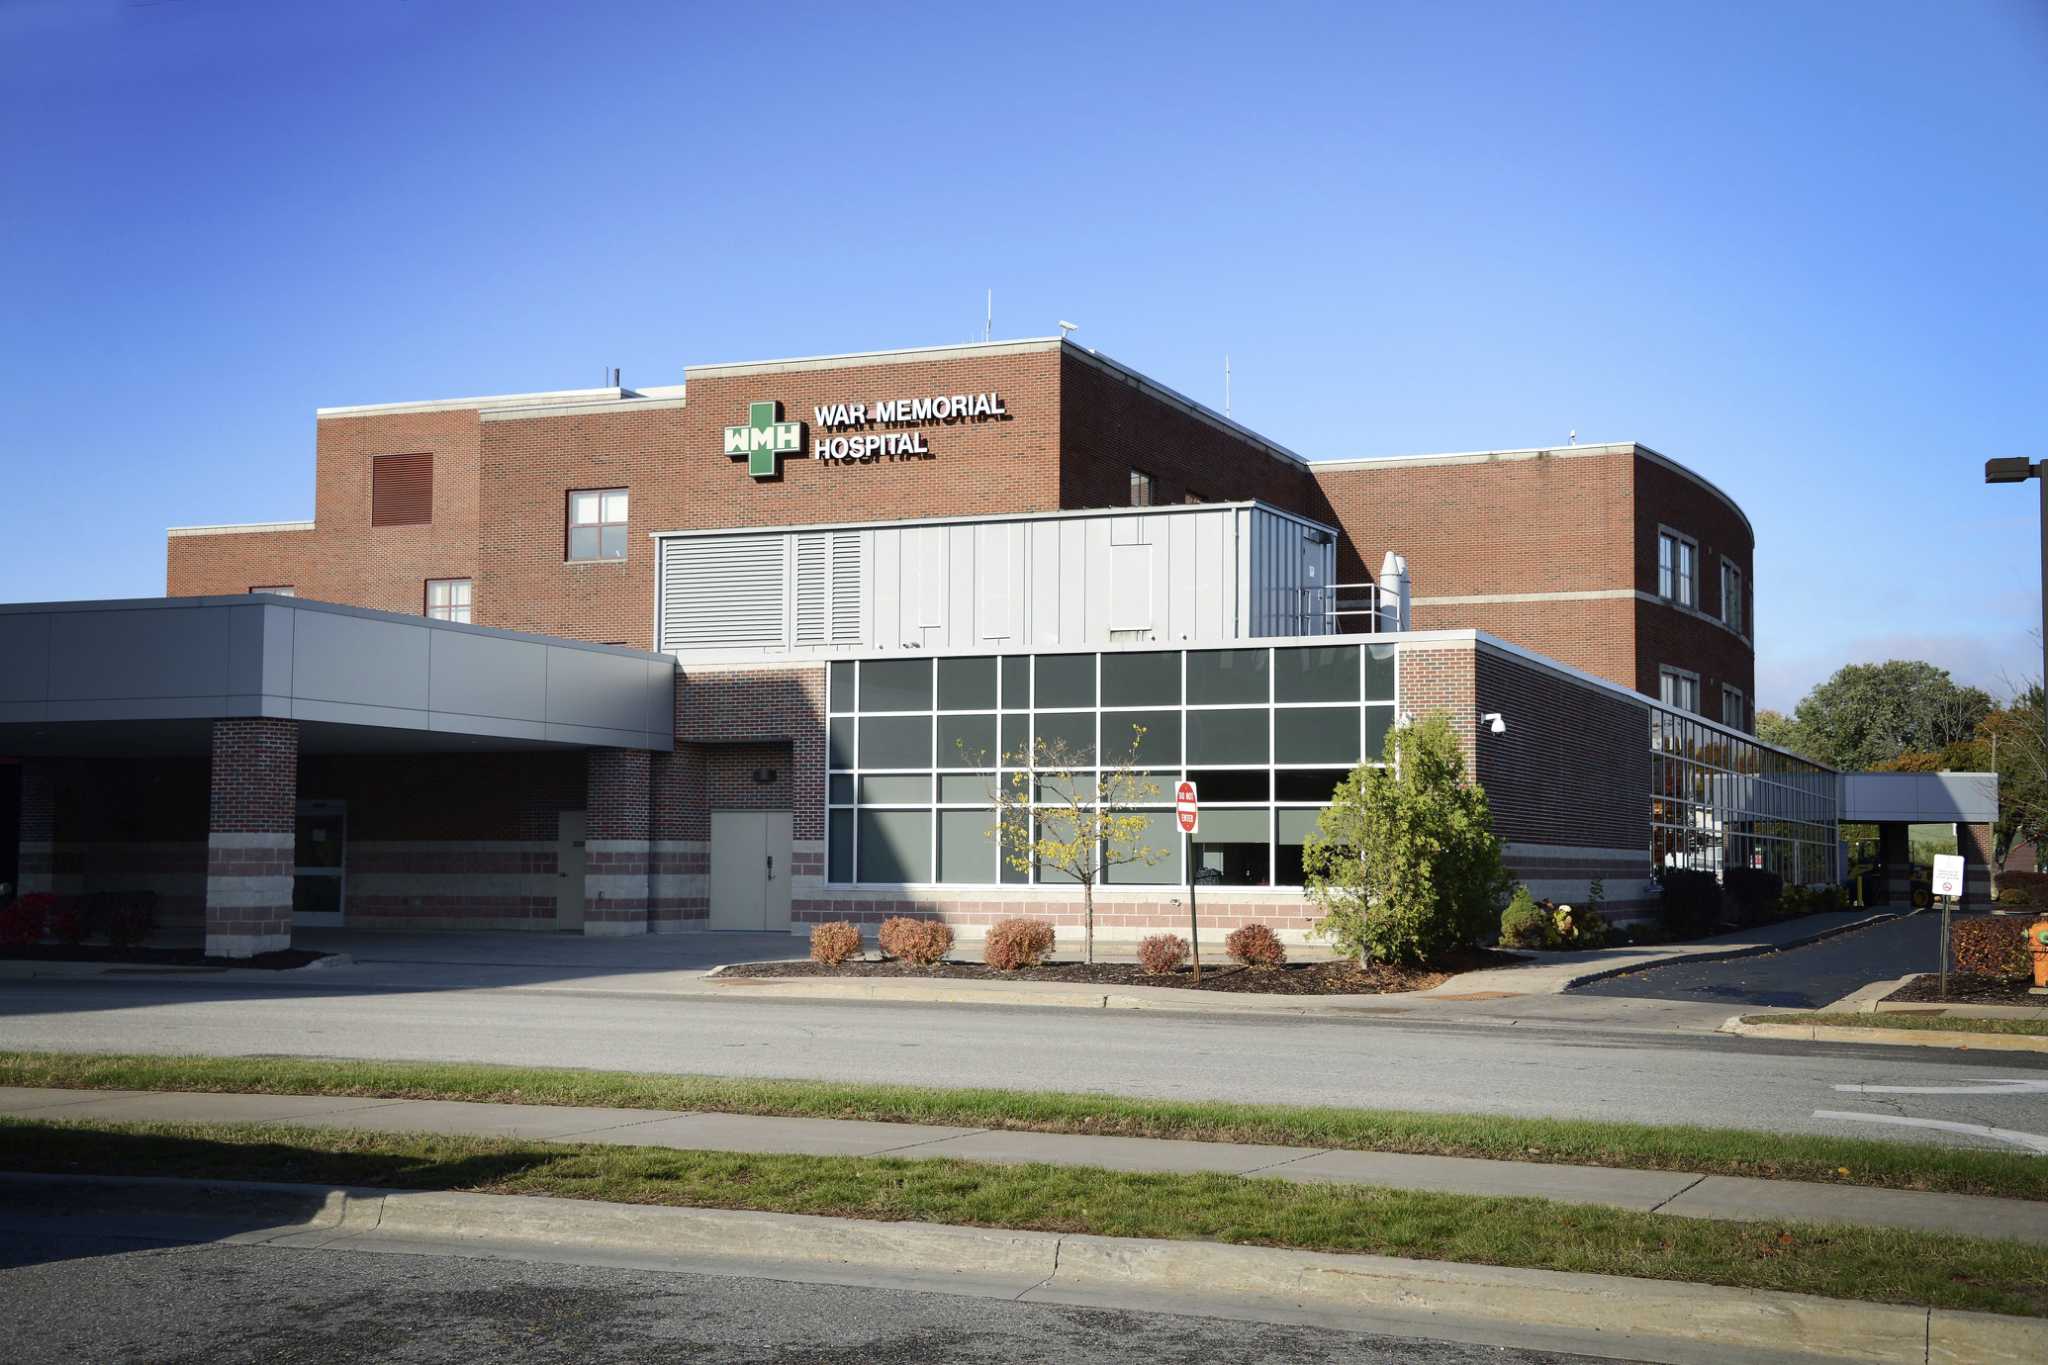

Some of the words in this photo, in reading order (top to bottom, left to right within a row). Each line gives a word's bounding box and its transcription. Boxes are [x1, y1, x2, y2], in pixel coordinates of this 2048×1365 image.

[815, 404, 866, 426] WAR
[876, 393, 1005, 423] MEMORIAL
[724, 425, 800, 451] WMH
[815, 432, 928, 459] HOSPITAL
